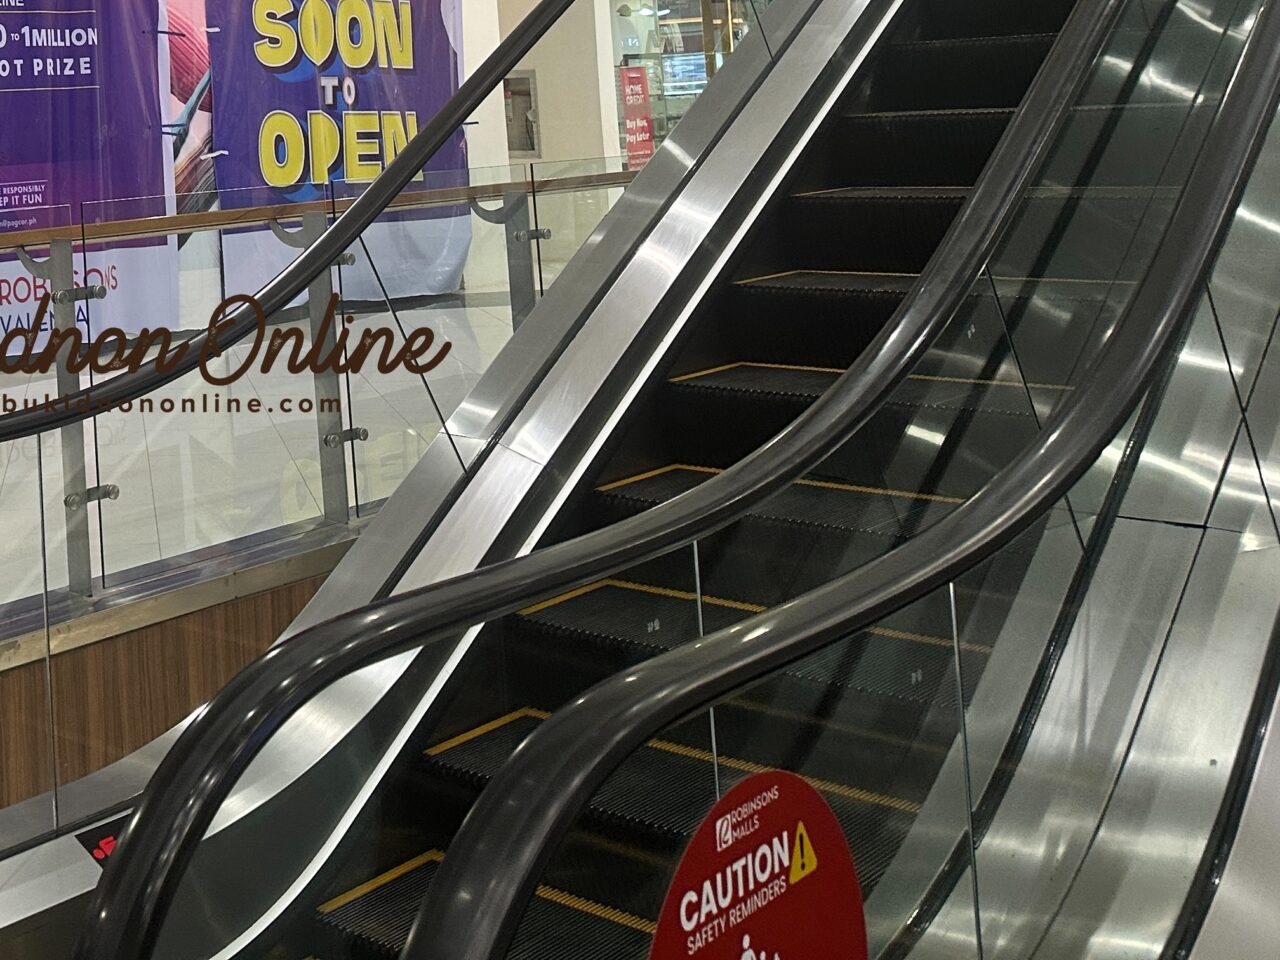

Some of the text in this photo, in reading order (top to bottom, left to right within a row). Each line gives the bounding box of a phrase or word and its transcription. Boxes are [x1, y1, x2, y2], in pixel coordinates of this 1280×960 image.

[10, 32, 20, 41] TO
[33, 57, 92, 76] PRIZE
[320, 76, 356, 106] TO
[625, 84, 642, 95] HOME
[625, 95, 645, 105] CREDIT
[258, 109, 424, 188] OPEN
[2, 184, 45, 195] RESPONSIBLY
[11, 195, 20, 206] IT
[22, 193, 43, 204] FUN
[730, 785, 779, 824] ROBINSONS
[732, 814, 760, 843] MALLS
[679, 830, 790, 932] CAUTION
[687, 876, 787, 956] SAFETY REMINDERS
